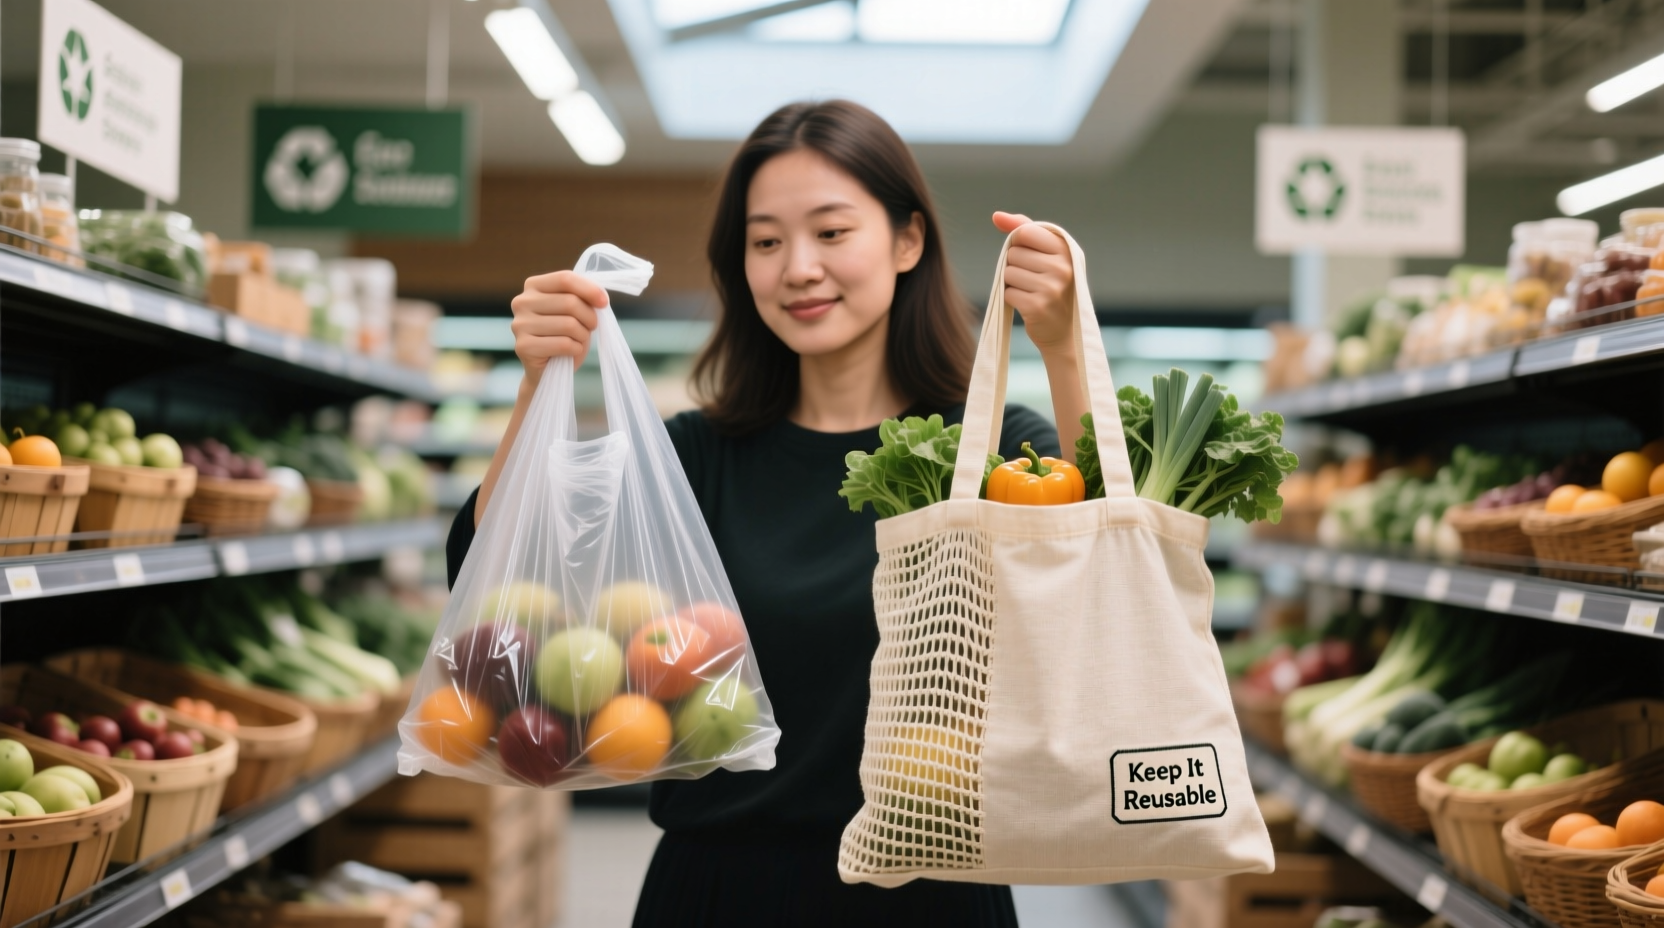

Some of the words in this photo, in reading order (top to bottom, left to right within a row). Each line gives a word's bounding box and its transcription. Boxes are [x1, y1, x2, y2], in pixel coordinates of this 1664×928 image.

[1128, 762, 1182, 785] Keep
[1187, 757, 1204, 778] It
[1124, 784, 1217, 810] Reusable
